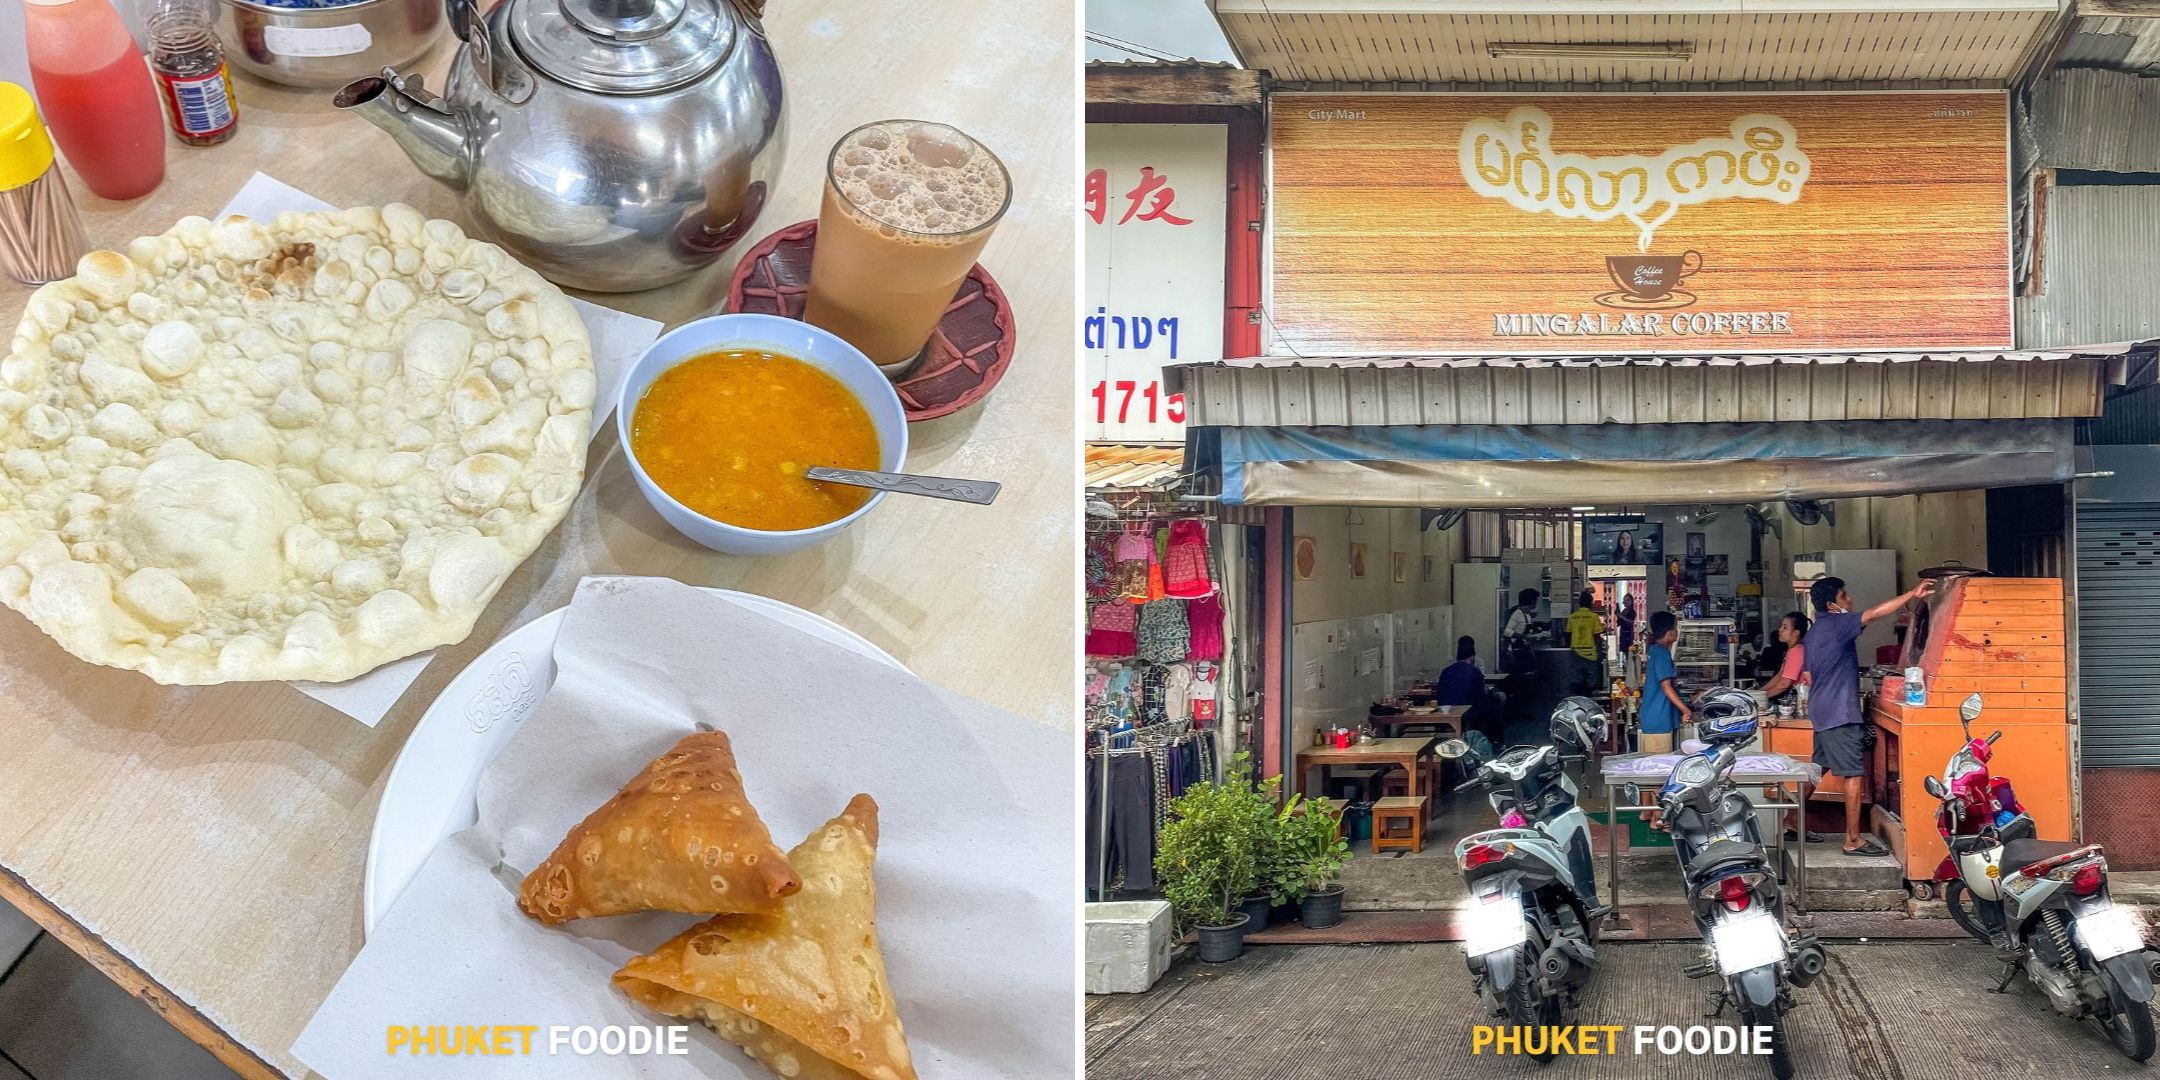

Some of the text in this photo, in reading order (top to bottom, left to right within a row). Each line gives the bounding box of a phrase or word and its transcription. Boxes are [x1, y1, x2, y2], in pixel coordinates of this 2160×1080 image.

[1308, 109, 1367, 121] City Mart
[1634, 264, 1664, 277] Coffee
[1633, 276, 1663, 286] House
[1492, 311, 1793, 337] MINGALAR COFFEE
